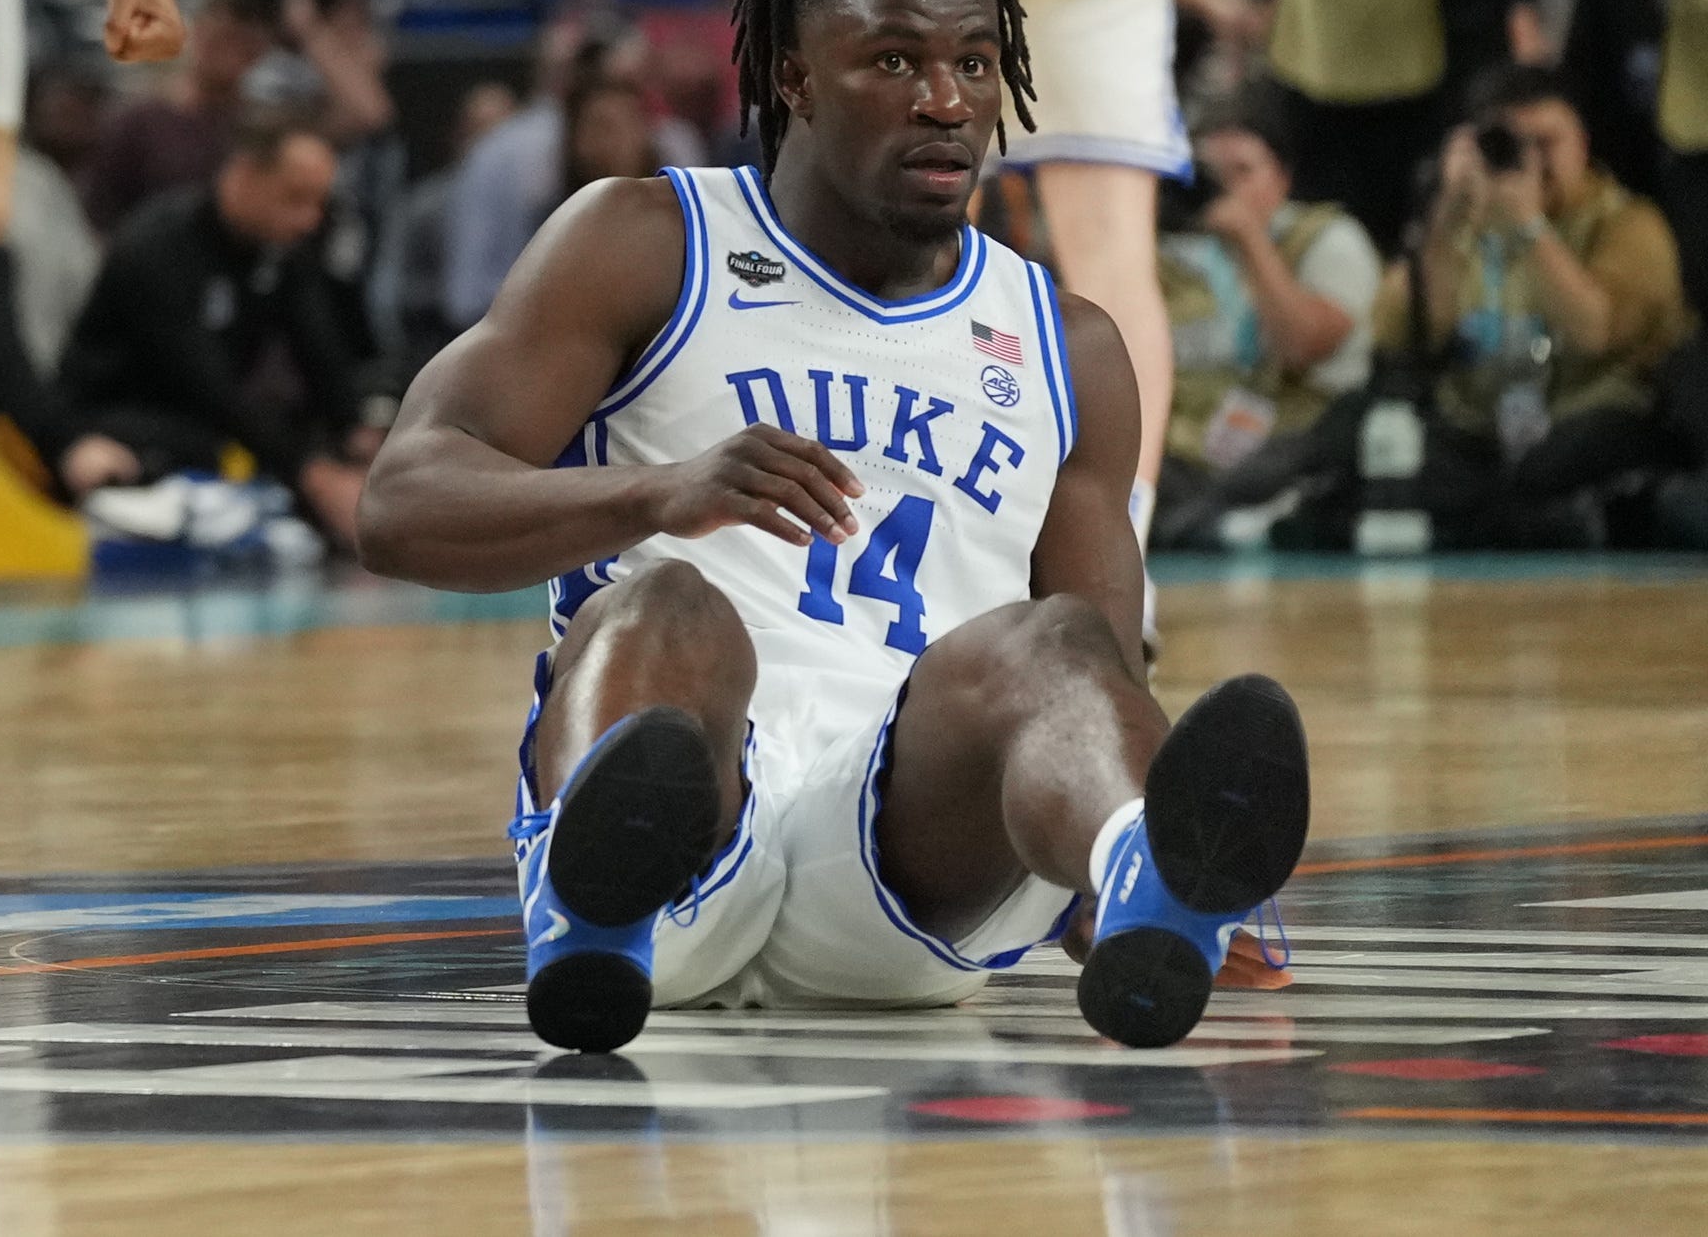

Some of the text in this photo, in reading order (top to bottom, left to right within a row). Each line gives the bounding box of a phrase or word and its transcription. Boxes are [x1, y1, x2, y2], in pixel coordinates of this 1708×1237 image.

[730, 257, 783, 275] FINAL FOUR
[726, 367, 1025, 515] DUKE
[798, 494, 935, 655] 14
